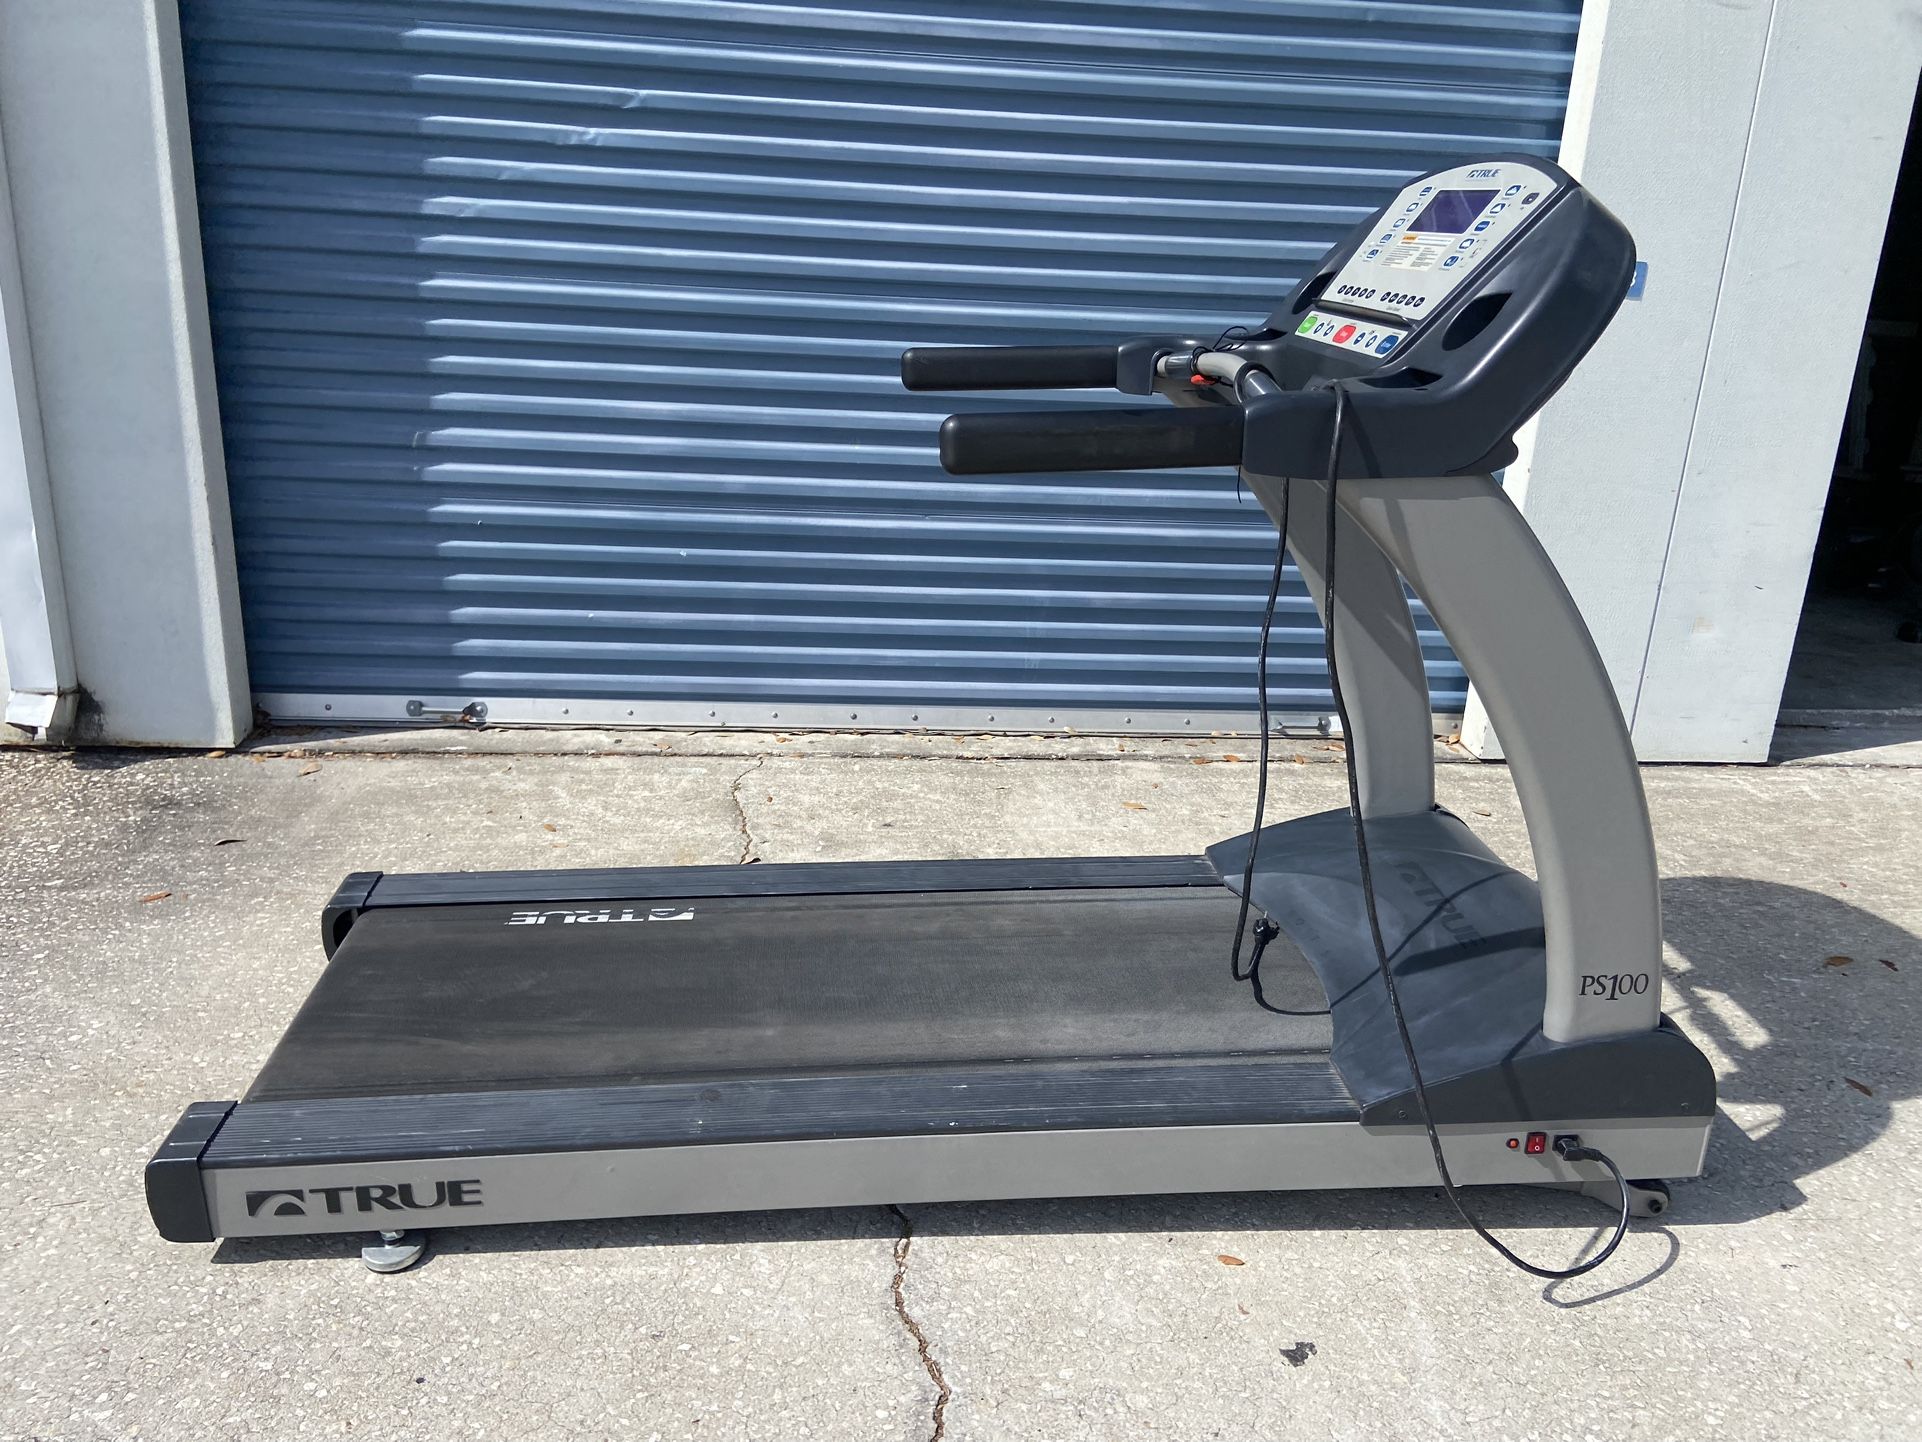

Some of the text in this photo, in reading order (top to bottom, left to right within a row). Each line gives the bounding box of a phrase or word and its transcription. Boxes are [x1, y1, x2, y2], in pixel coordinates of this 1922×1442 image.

[504, 908, 644, 926] TRUE
[1578, 973, 1649, 1000] PS100
[308, 1179, 483, 1214] TRUE
